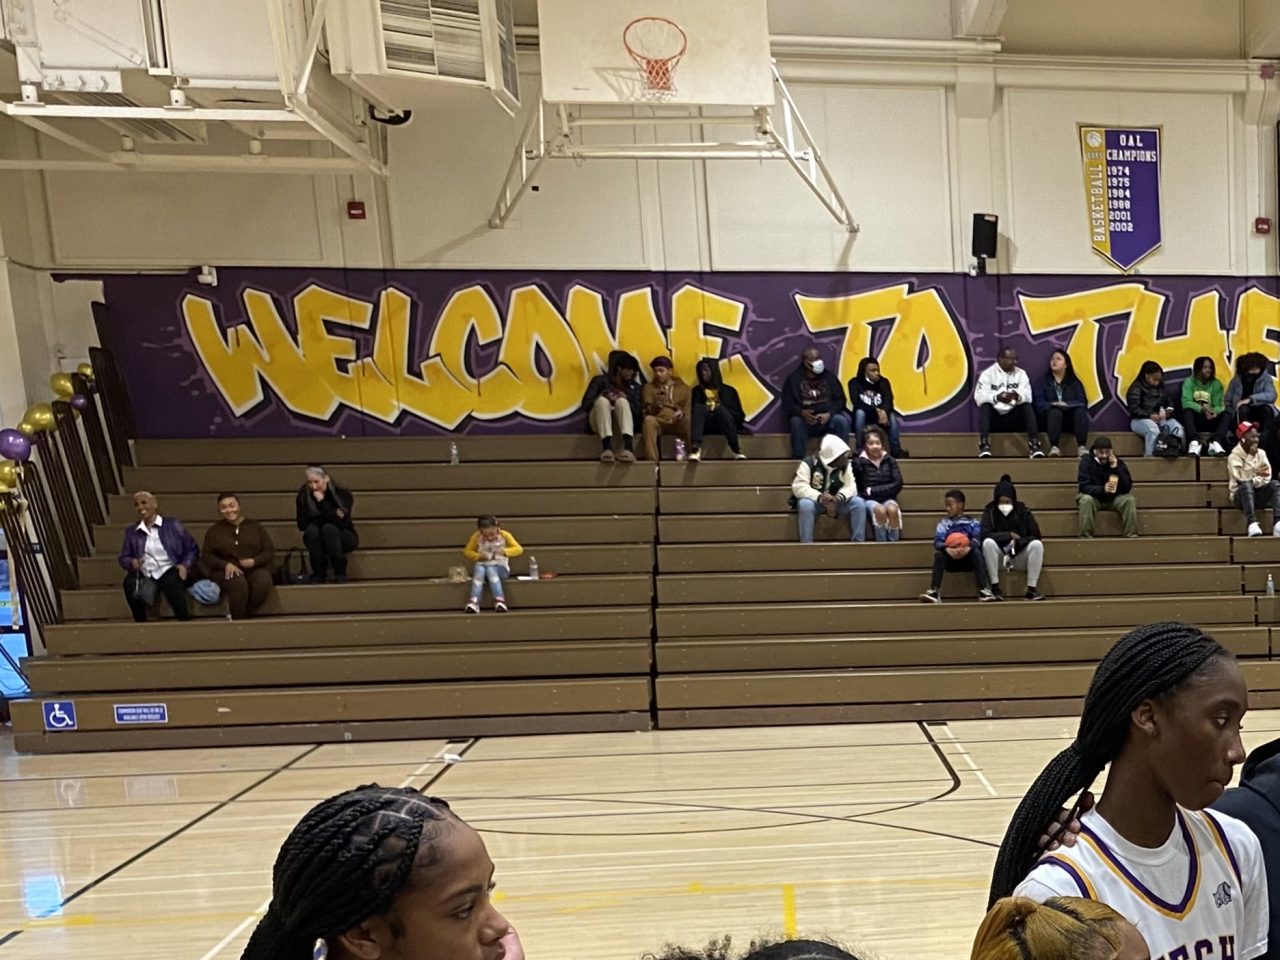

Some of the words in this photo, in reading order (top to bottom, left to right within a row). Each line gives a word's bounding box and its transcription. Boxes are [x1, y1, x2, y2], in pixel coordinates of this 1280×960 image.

[1119, 134, 1143, 147] OAL
[1106, 150, 1157, 162] CHAMPIONS
[1107, 166, 1130, 176] 1974
[1107, 177, 1130, 187] 1975
[1090, 164, 1105, 242] BASKETBALL
[1109, 211, 1131, 221] 2001
[1109, 222, 1134, 232] 2002
[182, 284, 775, 430] WELCOME
[795, 283, 969, 417] TO
